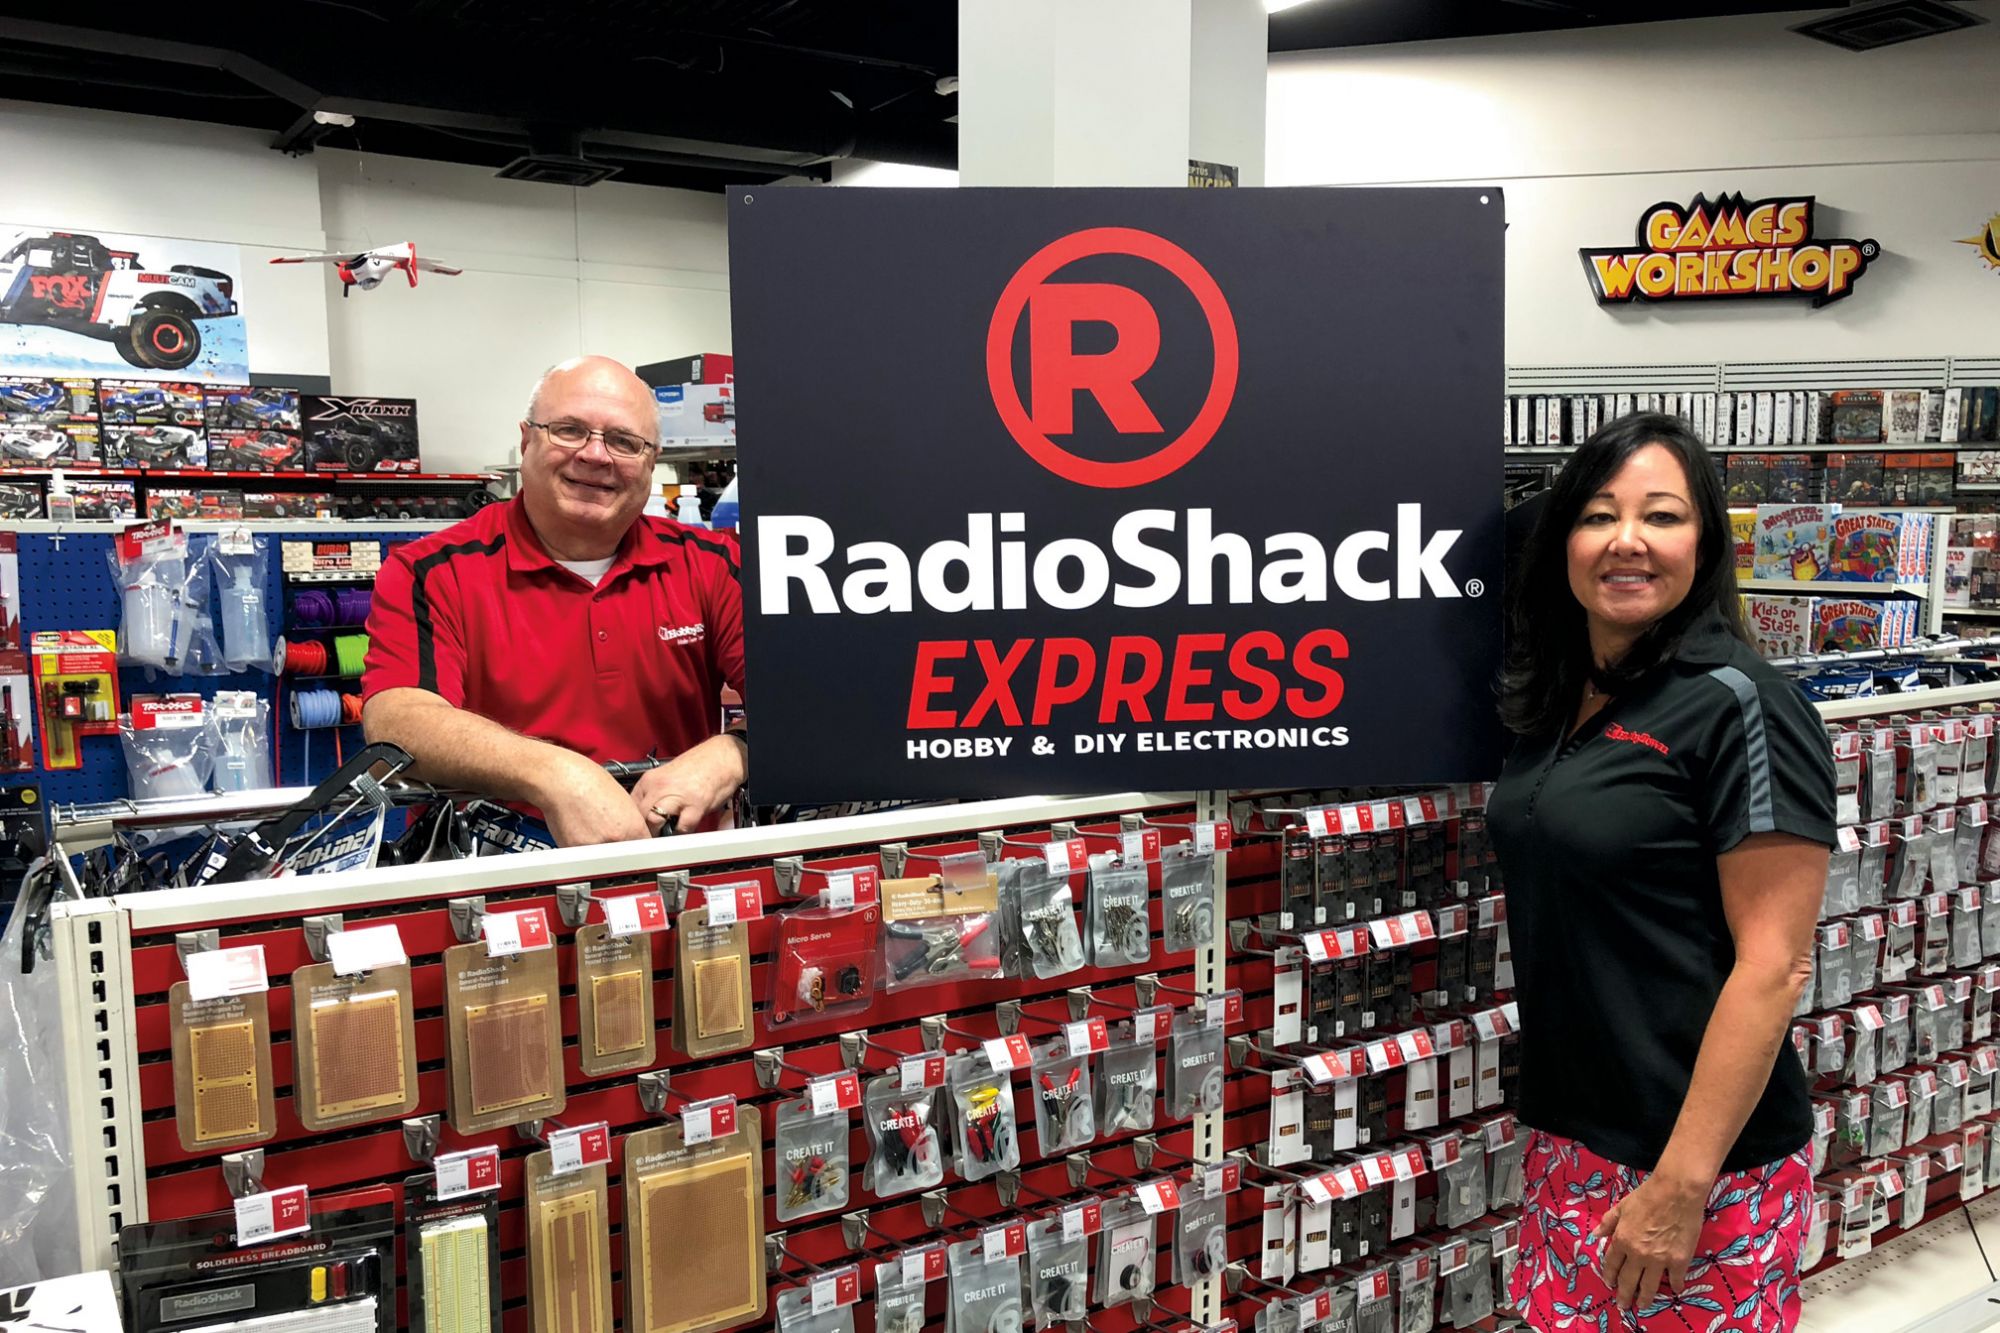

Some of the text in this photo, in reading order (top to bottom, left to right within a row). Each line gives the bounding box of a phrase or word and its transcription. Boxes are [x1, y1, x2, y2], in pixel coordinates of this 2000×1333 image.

[1646, 201, 1807, 250] GAMES
[138, 273, 196, 288] MULTICAM
[30, 275, 92, 309] FOX
[1835, 514, 1895, 538] GREAT STATES
[1752, 601, 1797, 619] Kids on
[1820, 602, 1877, 625] GREAT STATES
[1759, 616, 1800, 633] Stage
[906, 628, 1349, 729] EXPRESS
[906, 726, 1350, 760] HOBBY & DIY ELECTRONICS
[1170, 883, 1203, 898] CREATE IT
[1104, 895, 1139, 908] CREATE IT
[787, 932, 831, 945] Micro Servo
[467, 965, 507, 977] RadioShack
[459, 984, 477, 992] Printed
[1182, 1052, 1215, 1068] CREATE IT
[1110, 1069, 1147, 1085] CREATE IT
[1042, 1080, 1079, 1100] CREATE IT
[966, 1103, 996, 1120] CREATE
[880, 1116, 914, 1131] CREATE
[645, 1148, 688, 1163] RadioShack
[786, 1141, 834, 1160] CREATE IT
[281, 1197, 297, 1205] Only
[464, 1204, 487, 1212] SOCKET
[1185, 1212, 1216, 1233] CREATE IT
[196, 1253, 259, 1270] SOLDERLESS
[261, 1243, 326, 1260] BREADBOARD
[1040, 1261, 1078, 1280] CREATE IT
[174, 1291, 242, 1309] RadioShack
[887, 1294, 915, 1308] CREATE IT
[964, 1283, 1006, 1303] CREATE IT
[1325, 1319, 1347, 1333] CREATE
